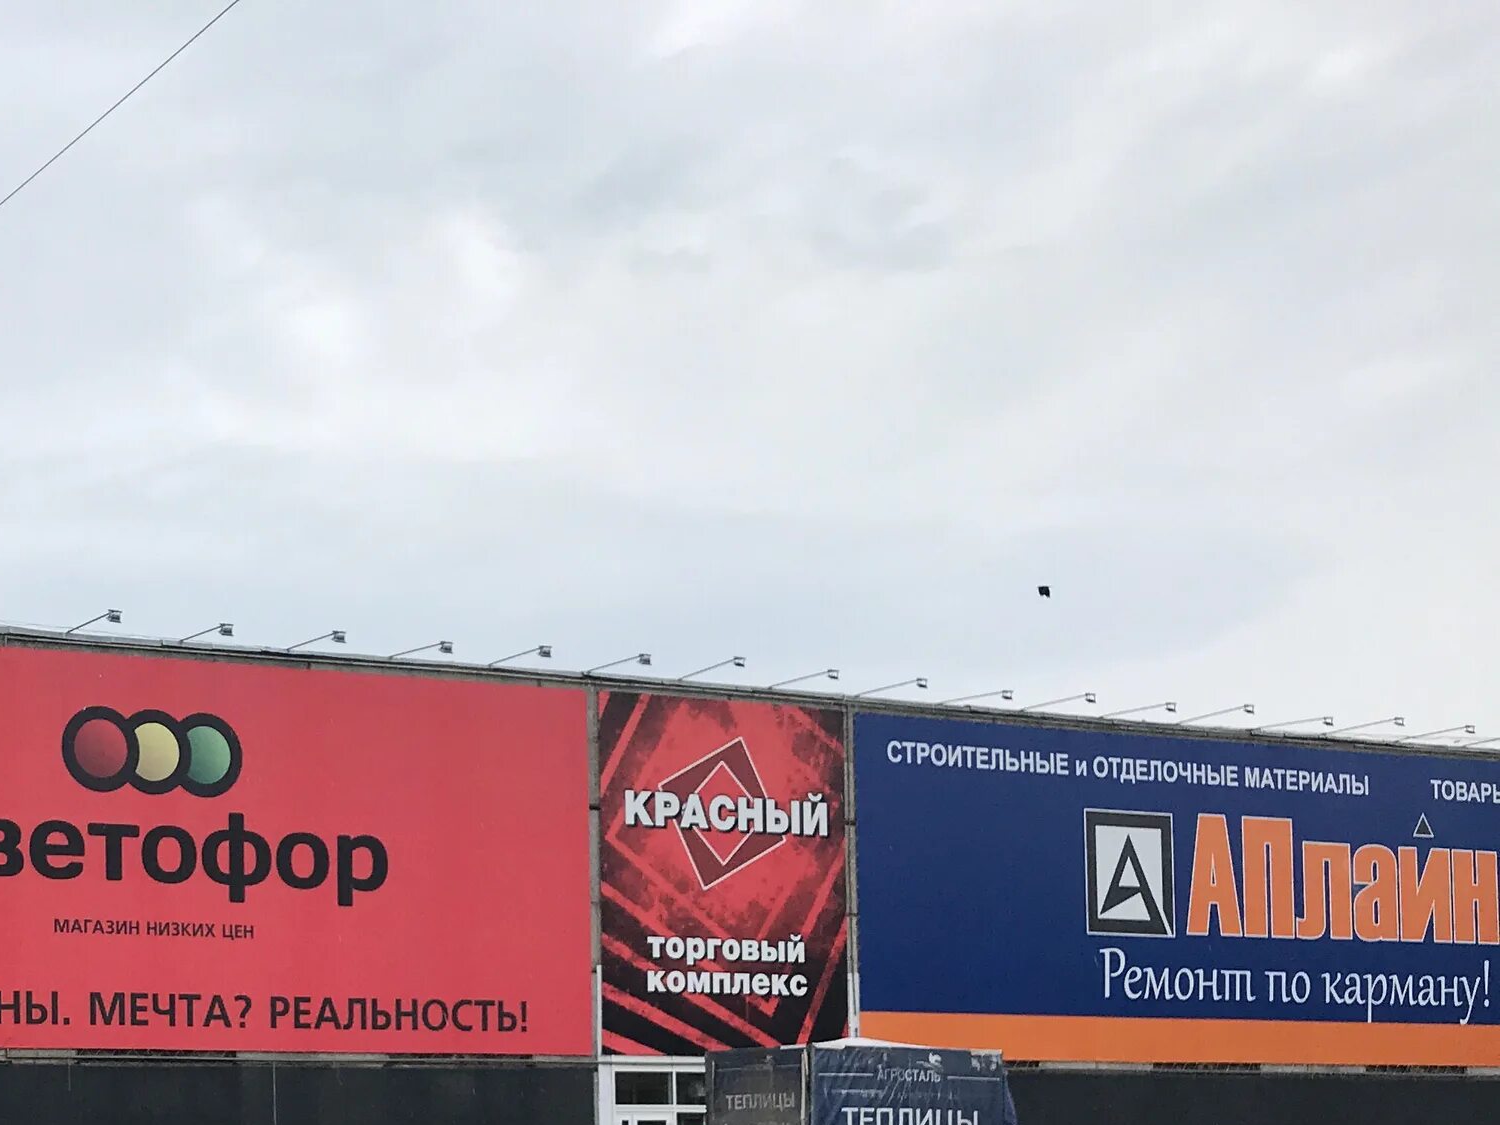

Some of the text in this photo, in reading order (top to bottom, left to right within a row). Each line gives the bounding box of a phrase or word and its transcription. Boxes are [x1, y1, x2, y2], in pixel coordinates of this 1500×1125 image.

[886, 740, 1370, 796] СТРОИТЕЛЬНЫЕ и ОТДЕЛОЧНЫЕ МАТЕРИАЛЫ
[624, 789, 830, 838] КРАСНЫЙ
[54, 918, 255, 941] МАГАЗИН НИЗКИХ ЦЕН
[646, 934, 806, 965] торговый
[646, 970, 808, 997] комплекс
[1099, 947, 1491, 1026] Ремонт по карману!
[89, 991, 252, 1029] МЕЧТА?
[269, 996, 529, 1032] РЕАЛЬНОСТЬ!
[725, 1092, 795, 1111] ТЕПЛИЦЫ
